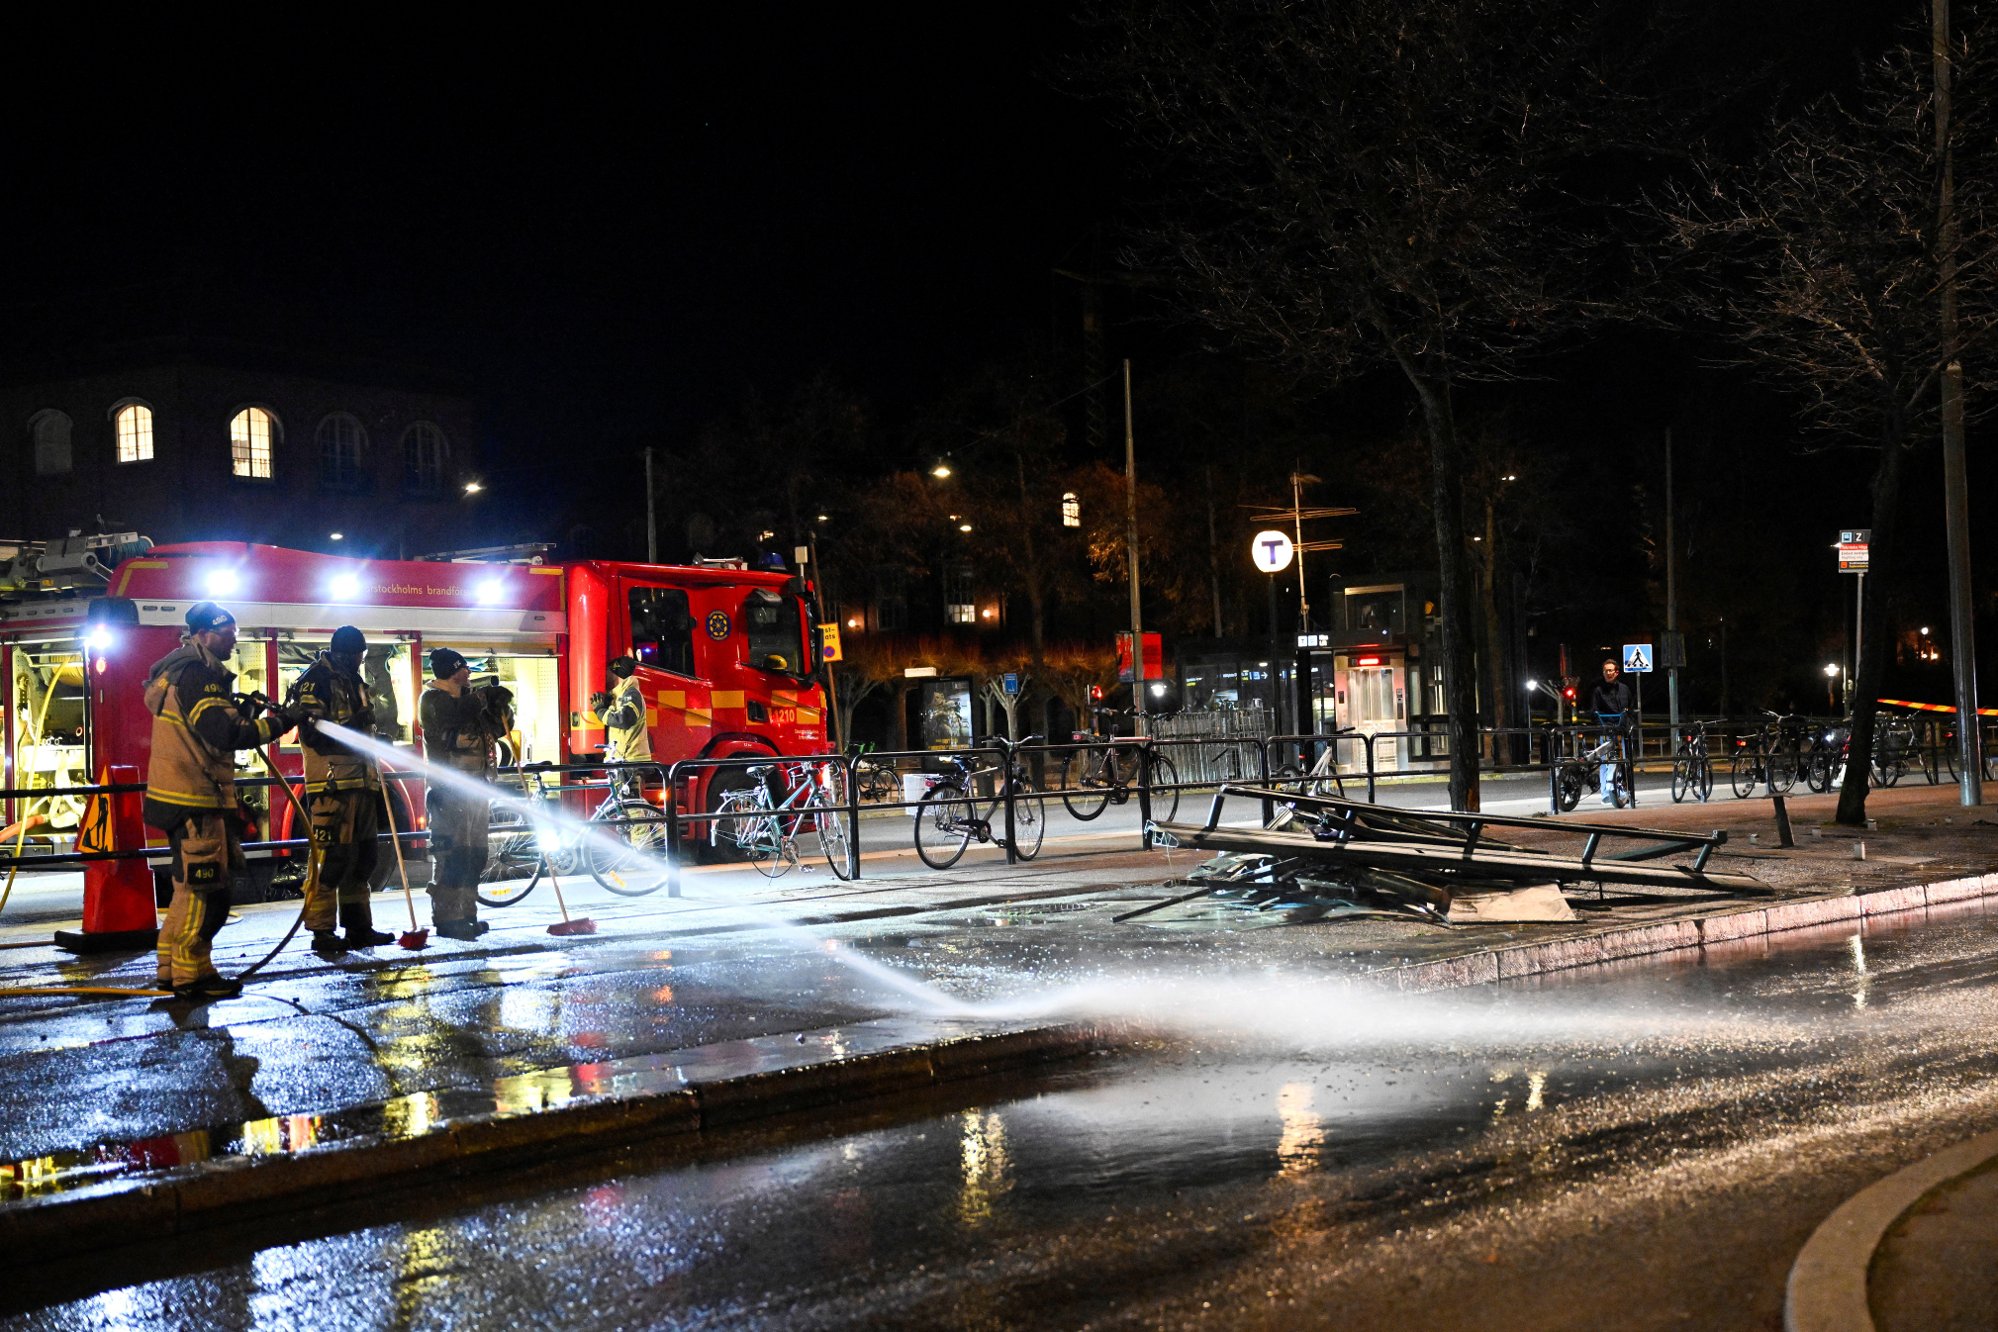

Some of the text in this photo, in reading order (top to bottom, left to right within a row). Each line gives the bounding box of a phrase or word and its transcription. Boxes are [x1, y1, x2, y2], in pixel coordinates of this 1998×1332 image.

[1856, 532, 1862, 541] Z
[1261, 540, 1283, 564] T
[195, 868, 214, 879] 490
